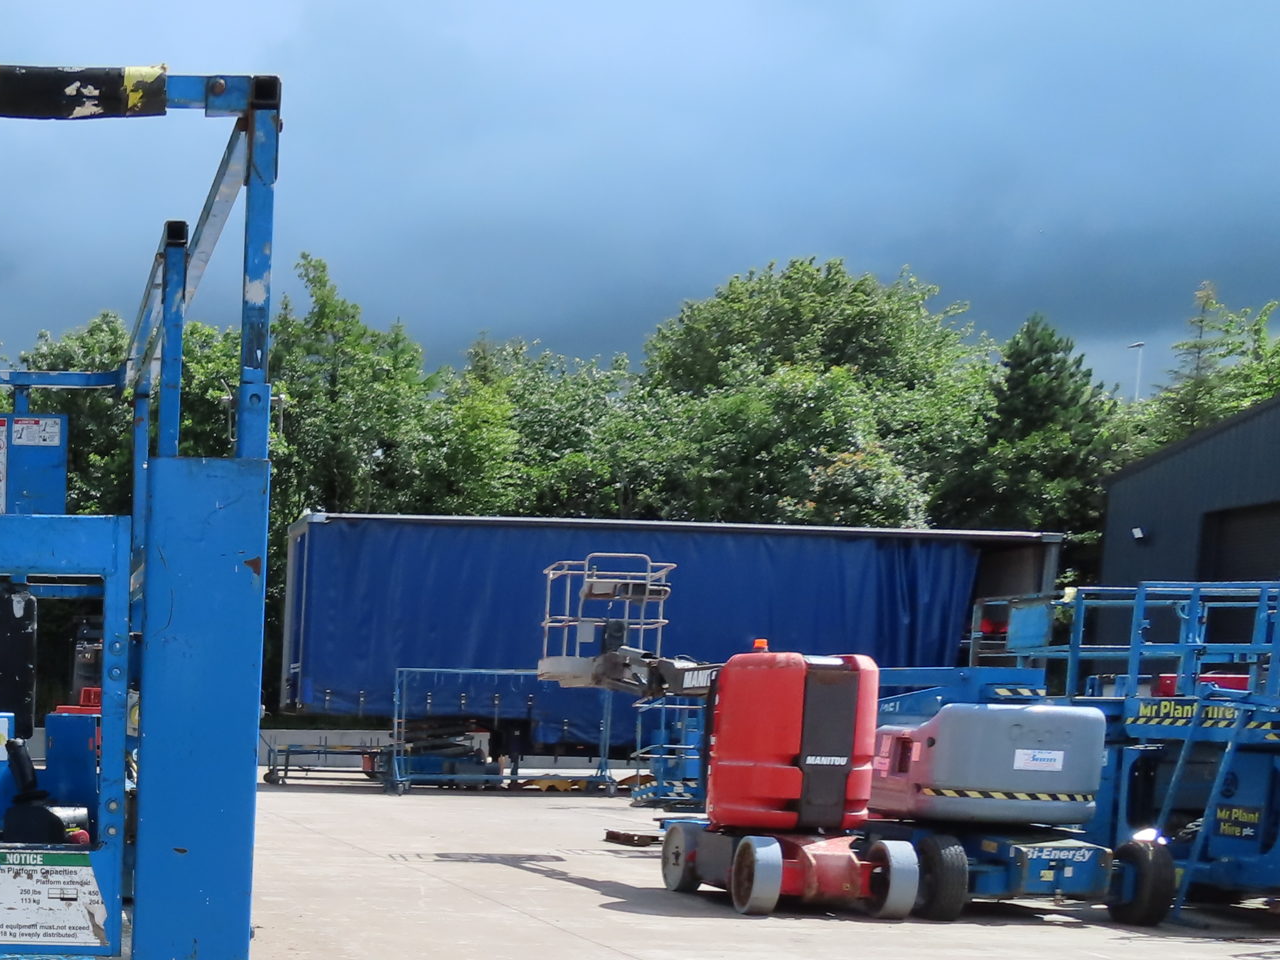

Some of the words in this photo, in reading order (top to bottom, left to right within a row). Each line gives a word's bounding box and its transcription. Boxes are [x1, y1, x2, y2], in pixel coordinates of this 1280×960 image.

[1139, 701, 1157, 717] Mr
[806, 755, 848, 766] MANITOU
[6, 853, 44, 865] NOTICE
[1027, 847, 1093, 862] Bi-Energy
[7, 867, 38, 875] Platform
[40, 868, 78, 876] Capacities
